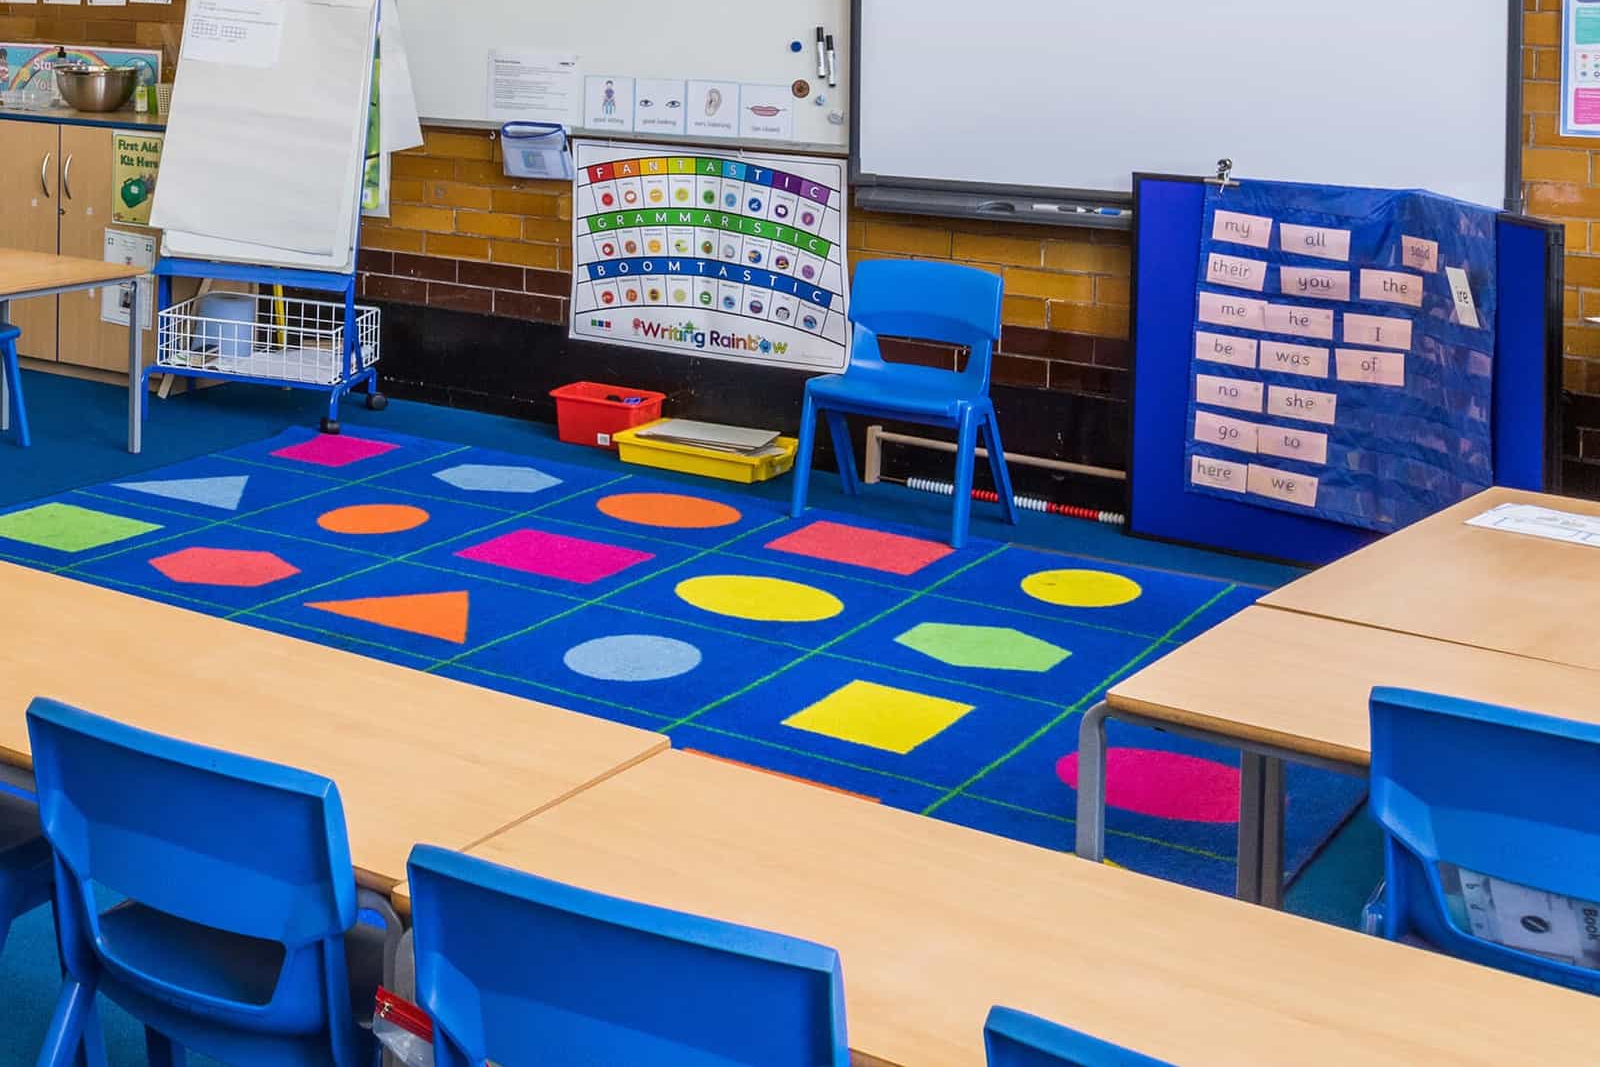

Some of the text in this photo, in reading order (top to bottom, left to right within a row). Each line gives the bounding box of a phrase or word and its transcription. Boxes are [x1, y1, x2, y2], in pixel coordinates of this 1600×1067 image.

[118, 139, 160, 152] First Aid
[120, 154, 134, 166] Kit
[596, 160, 819, 199] FANTASTIC
[597, 212, 819, 251] GRAMMARISTIC
[1224, 217, 1252, 238] my
[1305, 232, 1326, 248] all
[597, 260, 822, 303] BOOMTASTIC
[1212, 258, 1408, 294] their you the
[640, 320, 788, 354] Writing Rainbow
[1220, 303, 1382, 342] me he I
[1214, 340, 1378, 372] be was of
[1218, 384, 1314, 409] no she
[1218, 424, 1300, 448] go to
[1196, 462, 1296, 492] here we
[1583, 908, 1598, 940] Book
